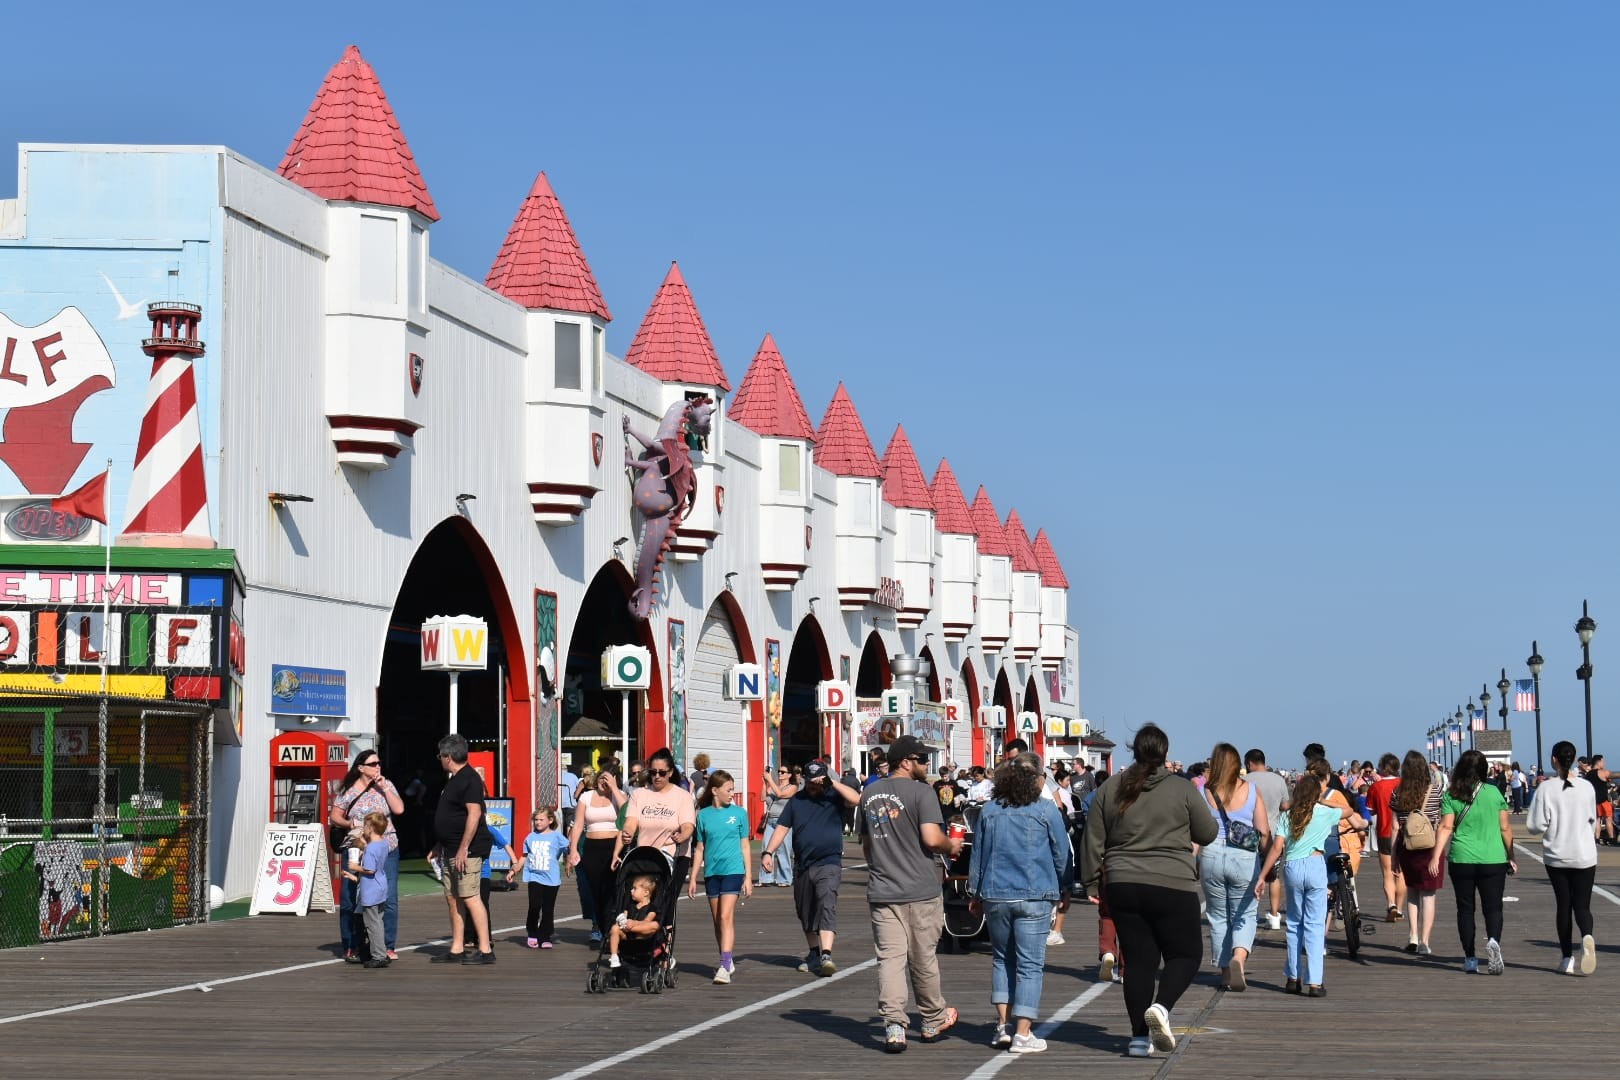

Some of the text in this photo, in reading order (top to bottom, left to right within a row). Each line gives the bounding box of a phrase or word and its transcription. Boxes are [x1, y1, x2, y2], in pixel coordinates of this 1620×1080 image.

[15, 507, 80, 537] OPEN
[39, 571, 169, 605] TIME
[421, 628, 484, 661] W W
[617, 655, 643, 683] O
[739, 673, 758, 695] N
[828, 687, 843, 707] D
[888, 696, 898, 713] E
[946, 705, 958, 720] R
[981, 711, 1004, 726] L L
[1021, 717, 1034, 730] A
[1050, 721, 1063, 734] N
[1071, 723, 1082, 735] D
[281, 746, 314, 761] ATM
[329, 746, 343, 761] ATM
[268, 832, 315, 841] Tee Time
[272, 842, 306, 857] Golf
[265, 858, 306, 906] $5
